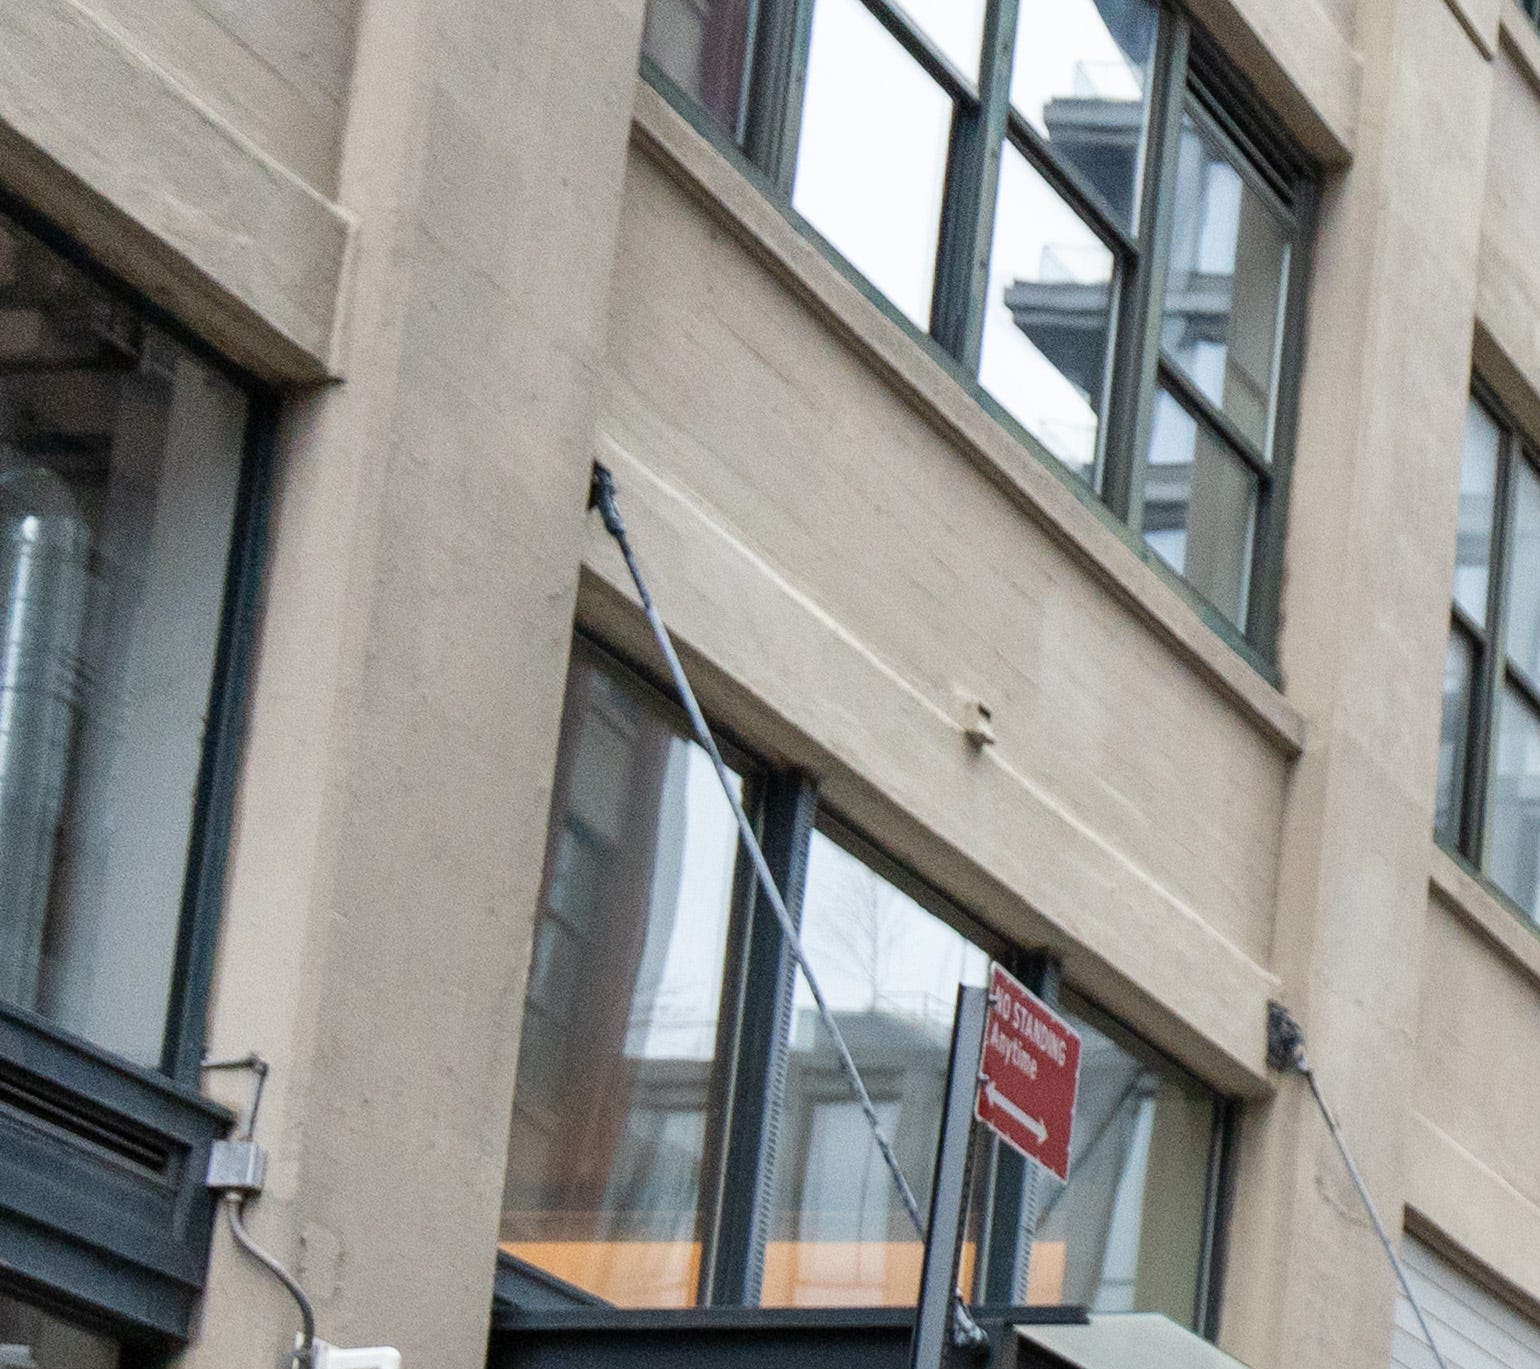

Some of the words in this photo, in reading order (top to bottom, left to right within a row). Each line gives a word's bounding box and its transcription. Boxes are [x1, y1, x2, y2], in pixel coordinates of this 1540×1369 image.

[990, 1021, 1038, 1081] Anytime
[993, 985, 1012, 1020] NO
[1012, 1002, 1067, 1067] STANDING
